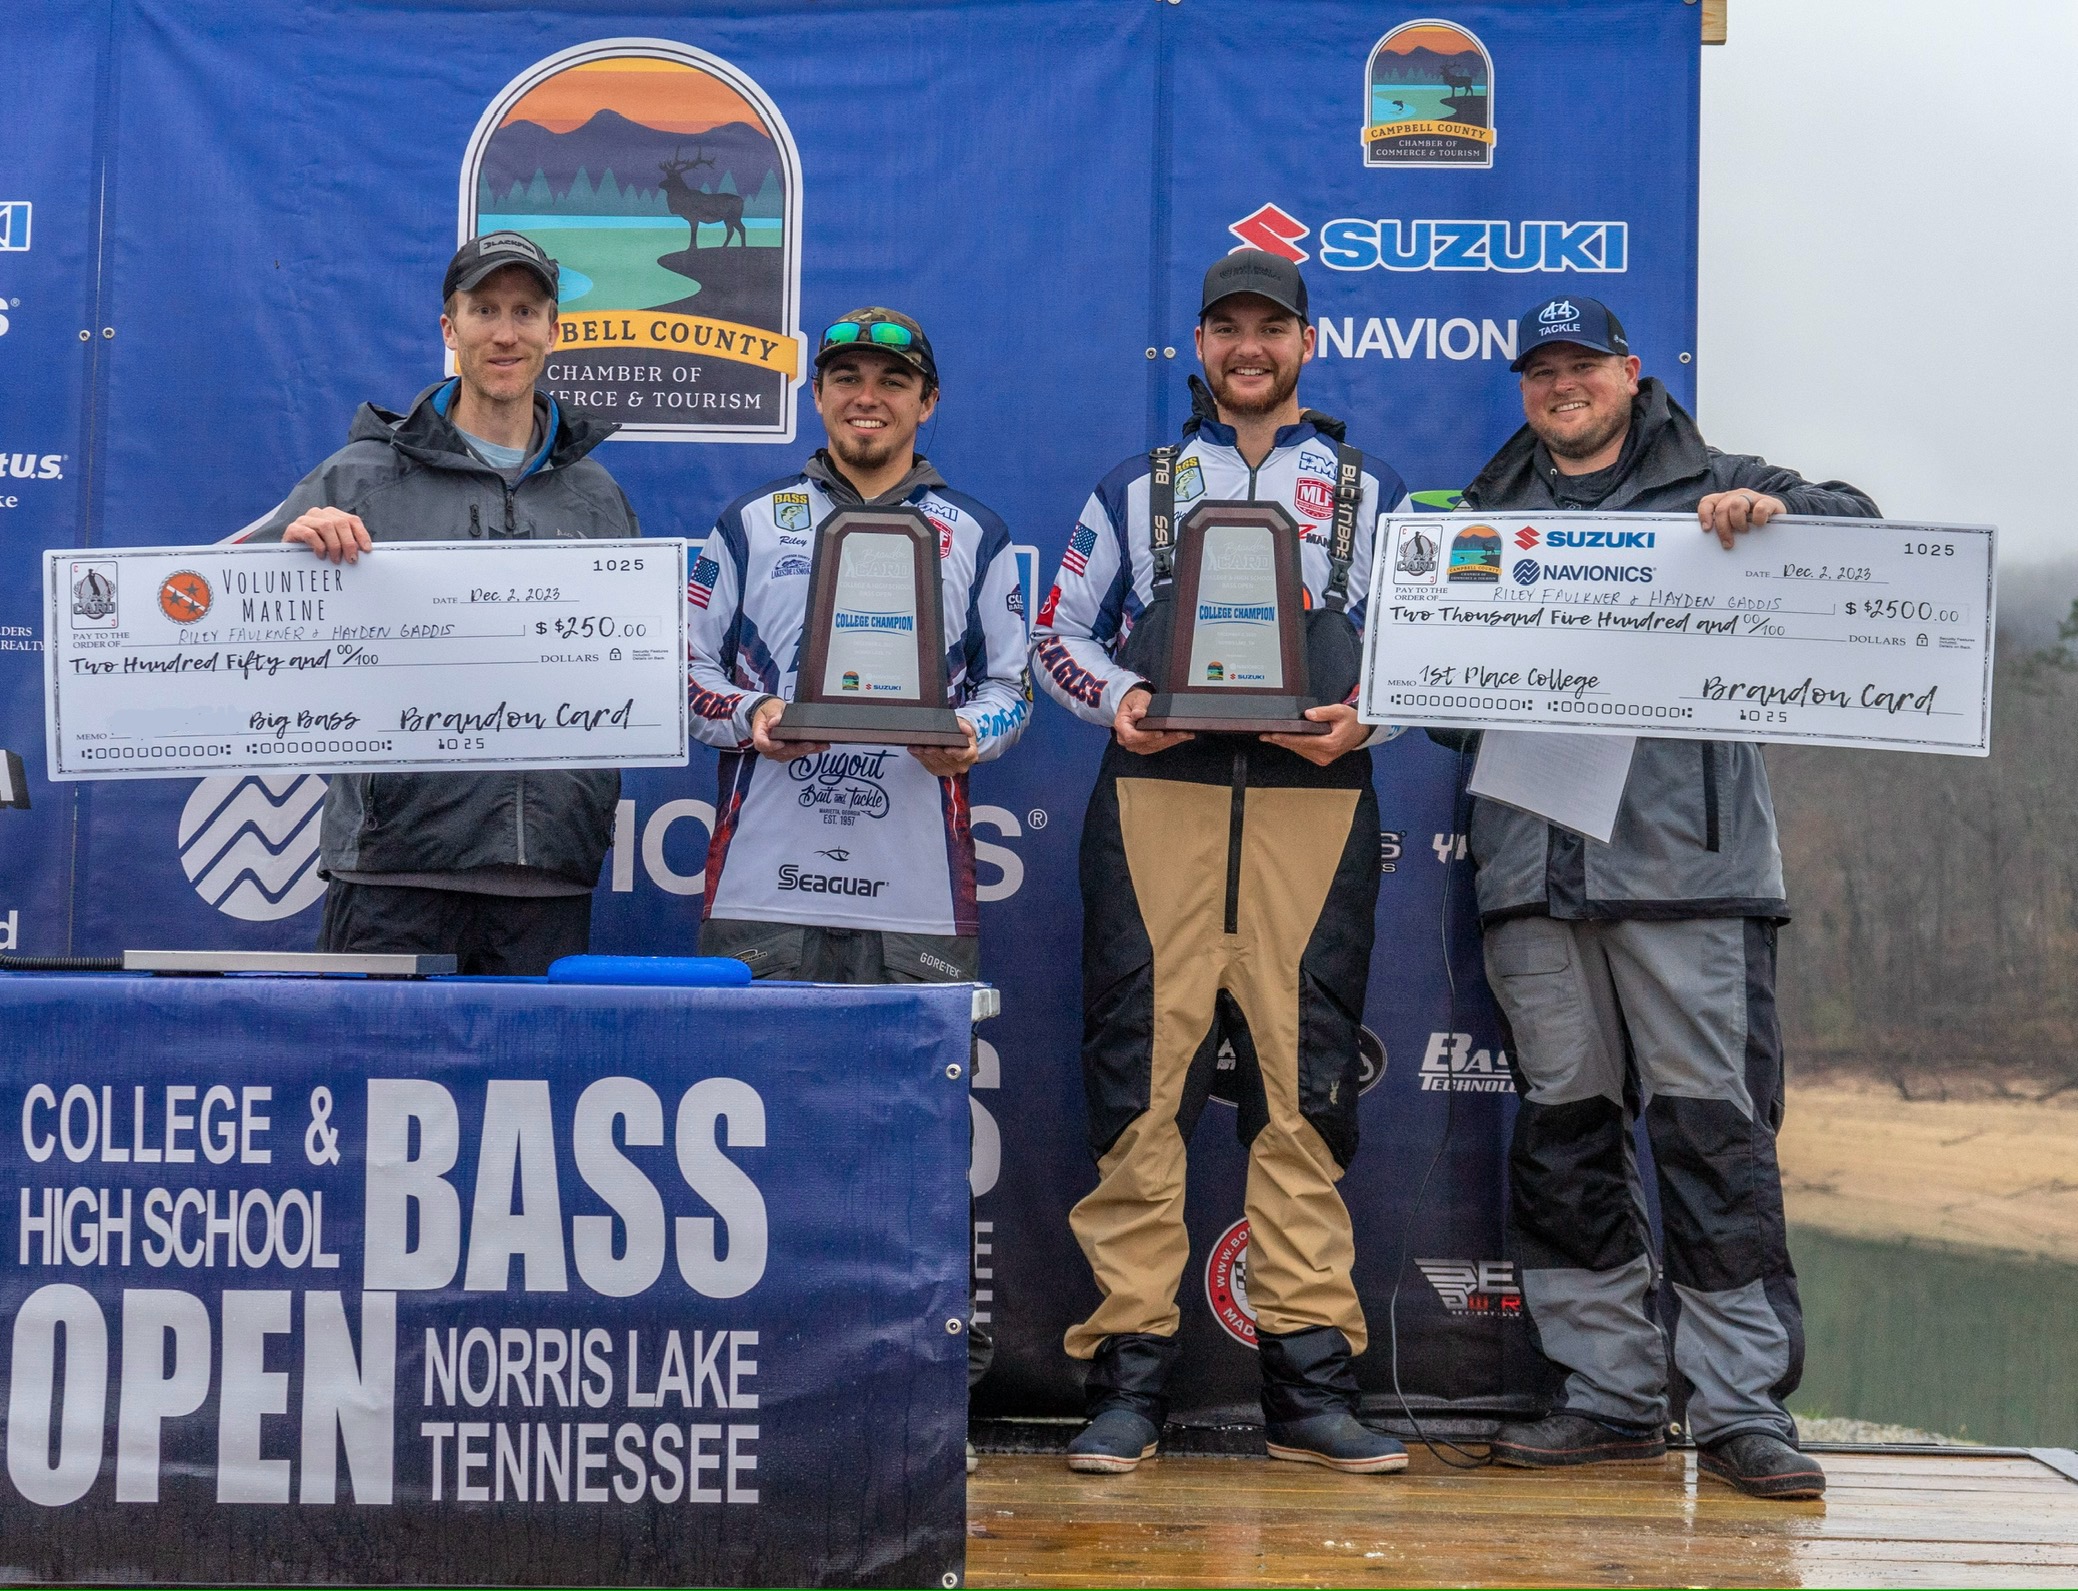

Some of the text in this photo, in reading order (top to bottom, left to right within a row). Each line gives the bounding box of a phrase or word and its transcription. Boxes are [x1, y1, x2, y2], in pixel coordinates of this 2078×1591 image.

[1371, 124, 1486, 138] CAMPBELL COUNTY
[1439, 149, 1480, 157] TOURISM
[1320, 218, 1628, 272] SUZUKI
[1543, 300, 1572, 320] 44
[1318, 318, 1517, 361] NAVION
[1539, 323, 1581, 336] TACKLE
[561, 320, 779, 363] BELL COUNTY
[547, 364, 702, 383] CHAMBER OF
[549, 390, 762, 410] ERCE & TOURISM
[774, 493, 808, 506] BASS
[779, 535, 808, 548] Riley
[1546, 530, 1655, 549] SUZUKI
[1903, 542, 1955, 557] 1025
[593, 559, 645, 572] 1025
[1396, 560, 1437, 571] CARD
[1543, 565, 1653, 583] NAVIONICS
[1746, 570, 1770, 578] DATE
[1837, 567, 1871, 581] 2023
[222, 568, 343, 595] VOLUNTEER
[525, 587, 561, 601] 2023
[1494, 587, 1535, 601] RILEY
[1542, 588, 1621, 605] FAULKNER
[1650, 589, 1715, 608] HAYDEN
[1728, 597, 1782, 611] GADDIS
[73, 602, 115, 615] CARD
[242, 600, 325, 622] MARINE
[1199, 605, 1275, 622] COLLEGE CHAMPION
[1845, 599, 1959, 622] $ $2500.00
[535, 616, 647, 640] $ $250.00
[835, 613, 913, 631] COLLEGE CHAMPION
[1390, 606, 1435, 623] Two
[1439, 607, 1545, 626] Thousand
[1551, 611, 1592, 626] Five
[1599, 611, 1691, 633] Hundred
[1697, 614, 1738, 635] and
[0, 626, 32, 637] DERS
[73, 633, 92, 641] PAY
[94, 632, 108, 640] TO
[178, 629, 219, 646] RILEY
[229, 626, 304, 642] FAULKNER
[332, 625, 391, 640] HAYDEN
[400, 623, 456, 638] GADDIS
[1849, 635, 1906, 647] DOLLARS
[105, 640, 121, 648] OF
[70, 657, 119, 674] Two
[124, 652, 219, 675] Hundred
[226, 650, 286, 680] Fifty
[289, 648, 331, 670] and
[540, 654, 600, 663] DOLLARS
[1387, 665, 1600, 699] MEMO 1st Place College
[1702, 676, 1938, 716] Brandon Card
[249, 709, 360, 739] Big Bass
[400, 698, 634, 734] Brandon Card
[76, 733, 107, 741] MEMO
[798, 784, 839, 807] Bait
[845, 787, 883, 808] Tackle
[823, 814, 855, 826] EST. 1957
[920, 952, 961, 979] GORE-TEX
[22, 1077, 768, 1299] COLLEGE & BASS
[20, 1187, 339, 1268] HIGH SCHOOL
[1223, 1308, 1255, 1337] MAD
[6, 1283, 759, 1506] OPEN NORRIS LAKE
[421, 1423, 760, 1504] TENNESSEE
